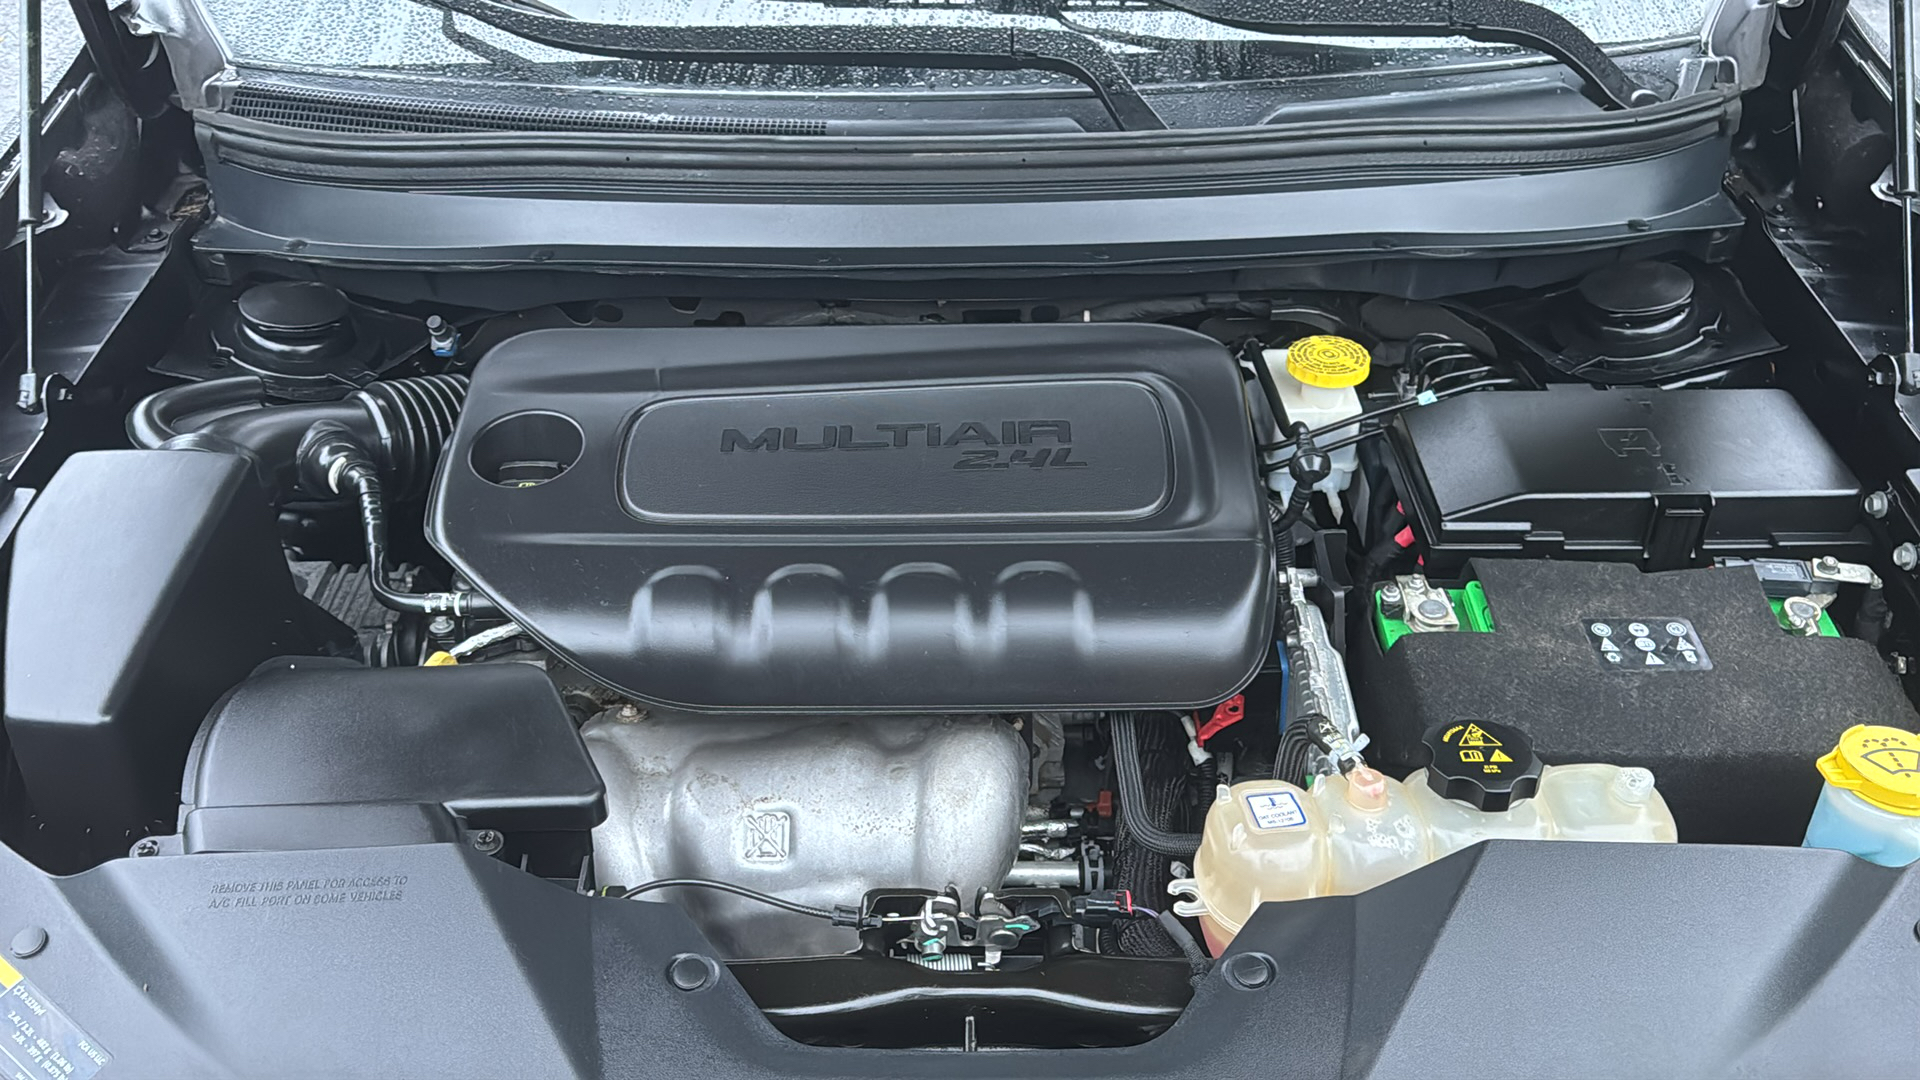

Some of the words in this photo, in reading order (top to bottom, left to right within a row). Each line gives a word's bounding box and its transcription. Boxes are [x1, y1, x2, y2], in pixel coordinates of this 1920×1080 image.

[720, 419, 1072, 452] MULTIAIR
[952, 448, 1088, 470] 2.4L
[210, 881, 257, 894] REMOVE
[258, 880, 284, 893] THIS
[285, 878, 321, 891] PANEL
[323, 877, 347, 889] FOR
[347, 876, 391, 888] ACCESS
[392, 875, 408, 886] TO
[207, 897, 231, 909] A/C
[234, 896, 257, 908] FILL
[260, 895, 292, 907] PORT
[294, 893, 312, 905] ON
[313, 892, 347, 904] SOME
[350, 889, 403, 903] VEHICLES
[77, 1039, 91, 1053] FCA
